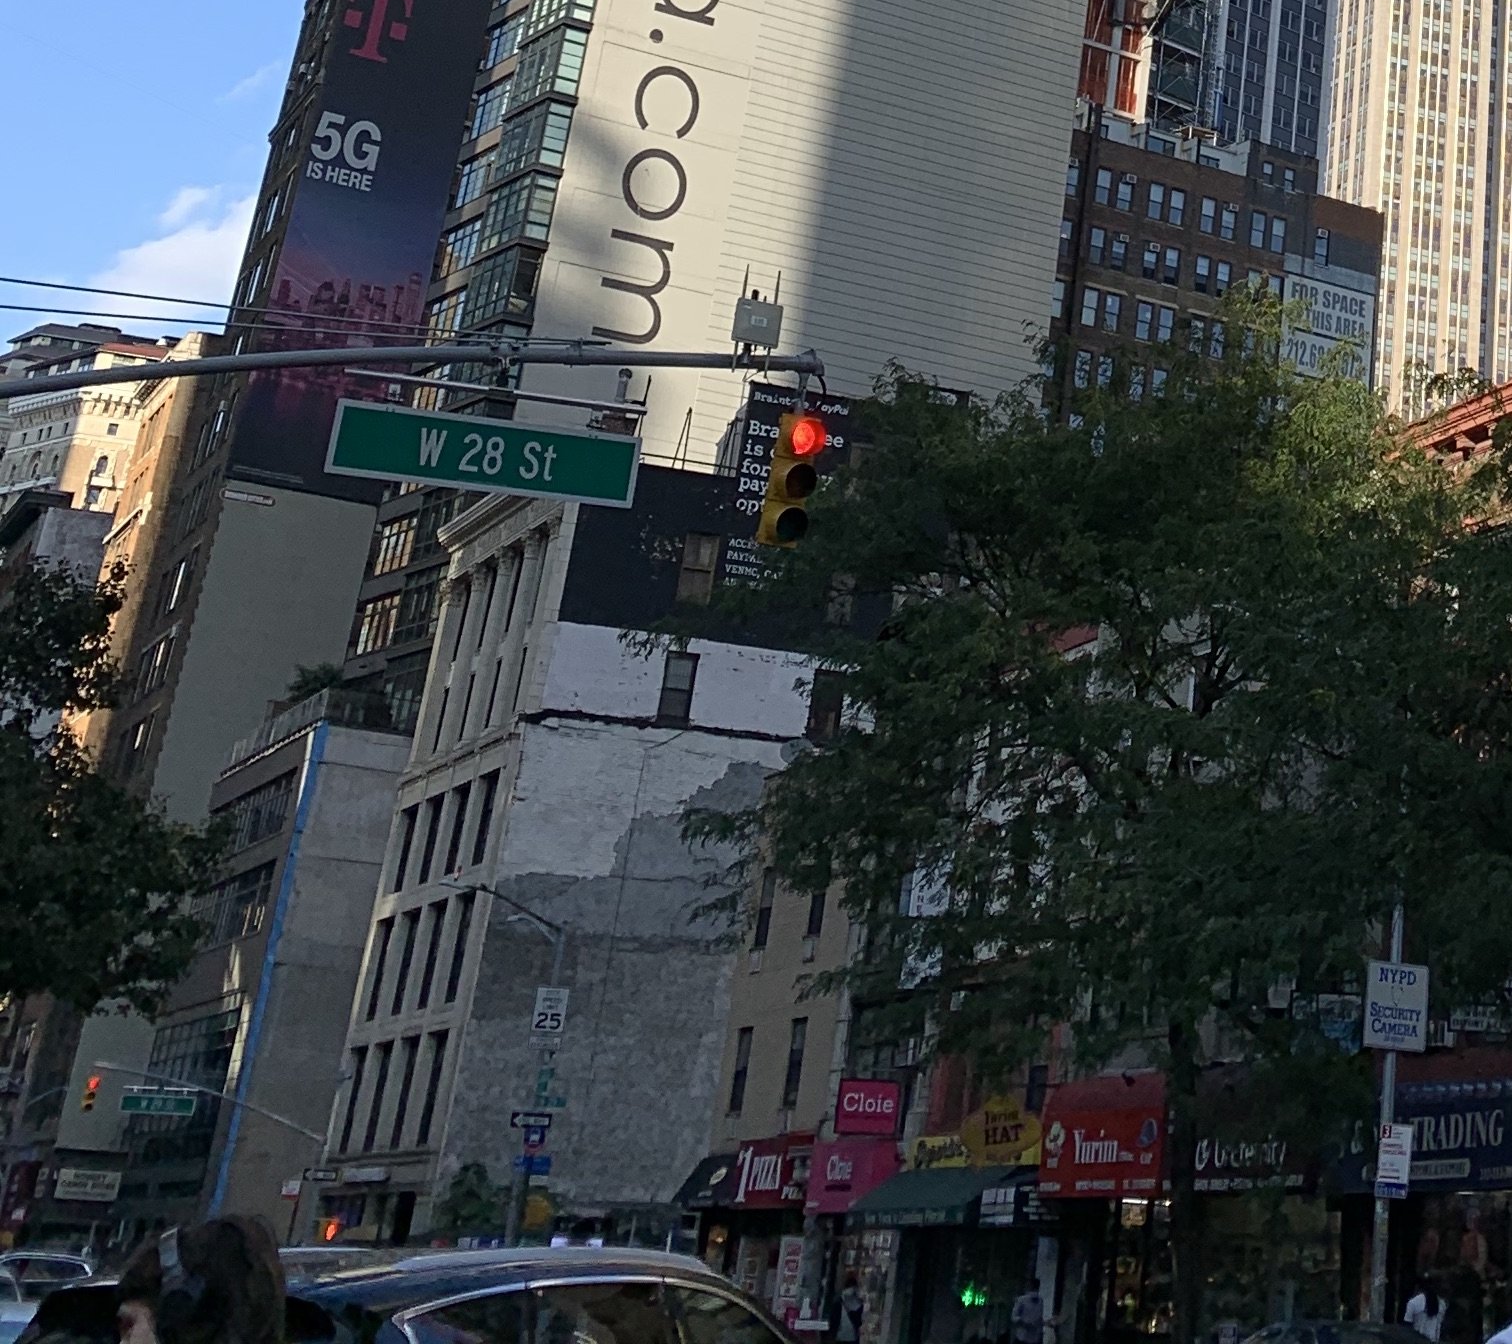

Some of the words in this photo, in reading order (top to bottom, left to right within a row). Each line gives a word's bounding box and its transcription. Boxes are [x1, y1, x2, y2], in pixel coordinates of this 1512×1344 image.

[311, 111, 382, 172] 5G
[305, 160, 324, 181] IS
[325, 166, 373, 192] HERE
[1322, 289, 1367, 319] SPACE
[419, 427, 448, 468] W
[458, 433, 505, 475] 28
[518, 441, 558, 482] St
[743, 438, 765, 457] is
[1378, 967, 1417, 986] NYPD
[535, 1012, 562, 1030] 25
[1370, 1001, 1422, 1023] SECURITY
[1371, 1018, 1418, 1038] CAMERA
[842, 1092, 895, 1113] Cloie
[984, 1122, 1024, 1146] HAT
[1408, 1108, 1505, 1153] TRADING
[1073, 1128, 1119, 1165] Yurim
[748, 1154, 783, 1192] PIZZA
